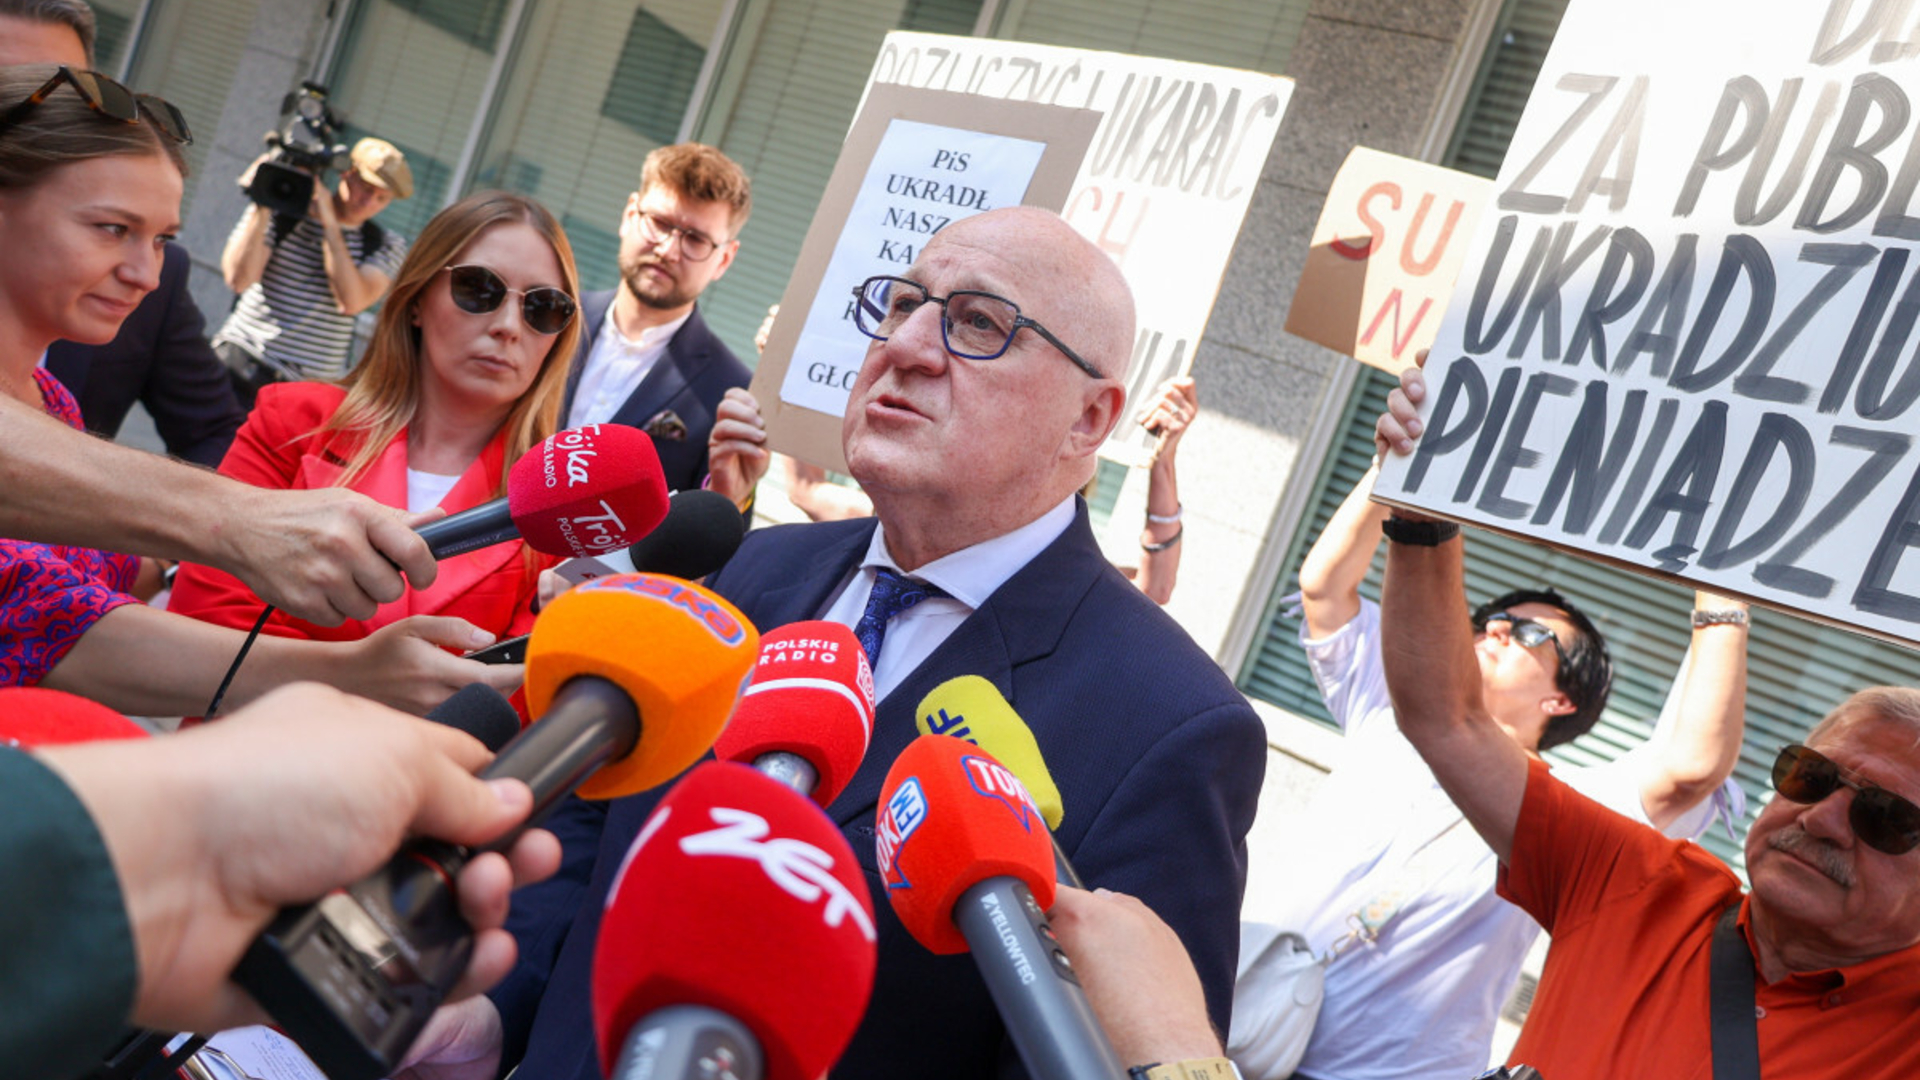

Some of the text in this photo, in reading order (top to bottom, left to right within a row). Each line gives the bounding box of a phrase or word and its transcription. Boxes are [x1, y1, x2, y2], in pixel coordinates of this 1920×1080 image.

[931, 149, 971, 172] PiS
[1497, 72, 1650, 214] ZA
[886, 173, 991, 211] UKRADŁ
[1403, 356, 1920, 624] PIENIĄDZE
[759, 650, 836, 666] RADIO
[763, 639, 839, 653] POLSKIE
[679, 806, 877, 942] ZET
[876, 783, 922, 886] OK FM
[989, 904, 1036, 986] YELLOWTEC
